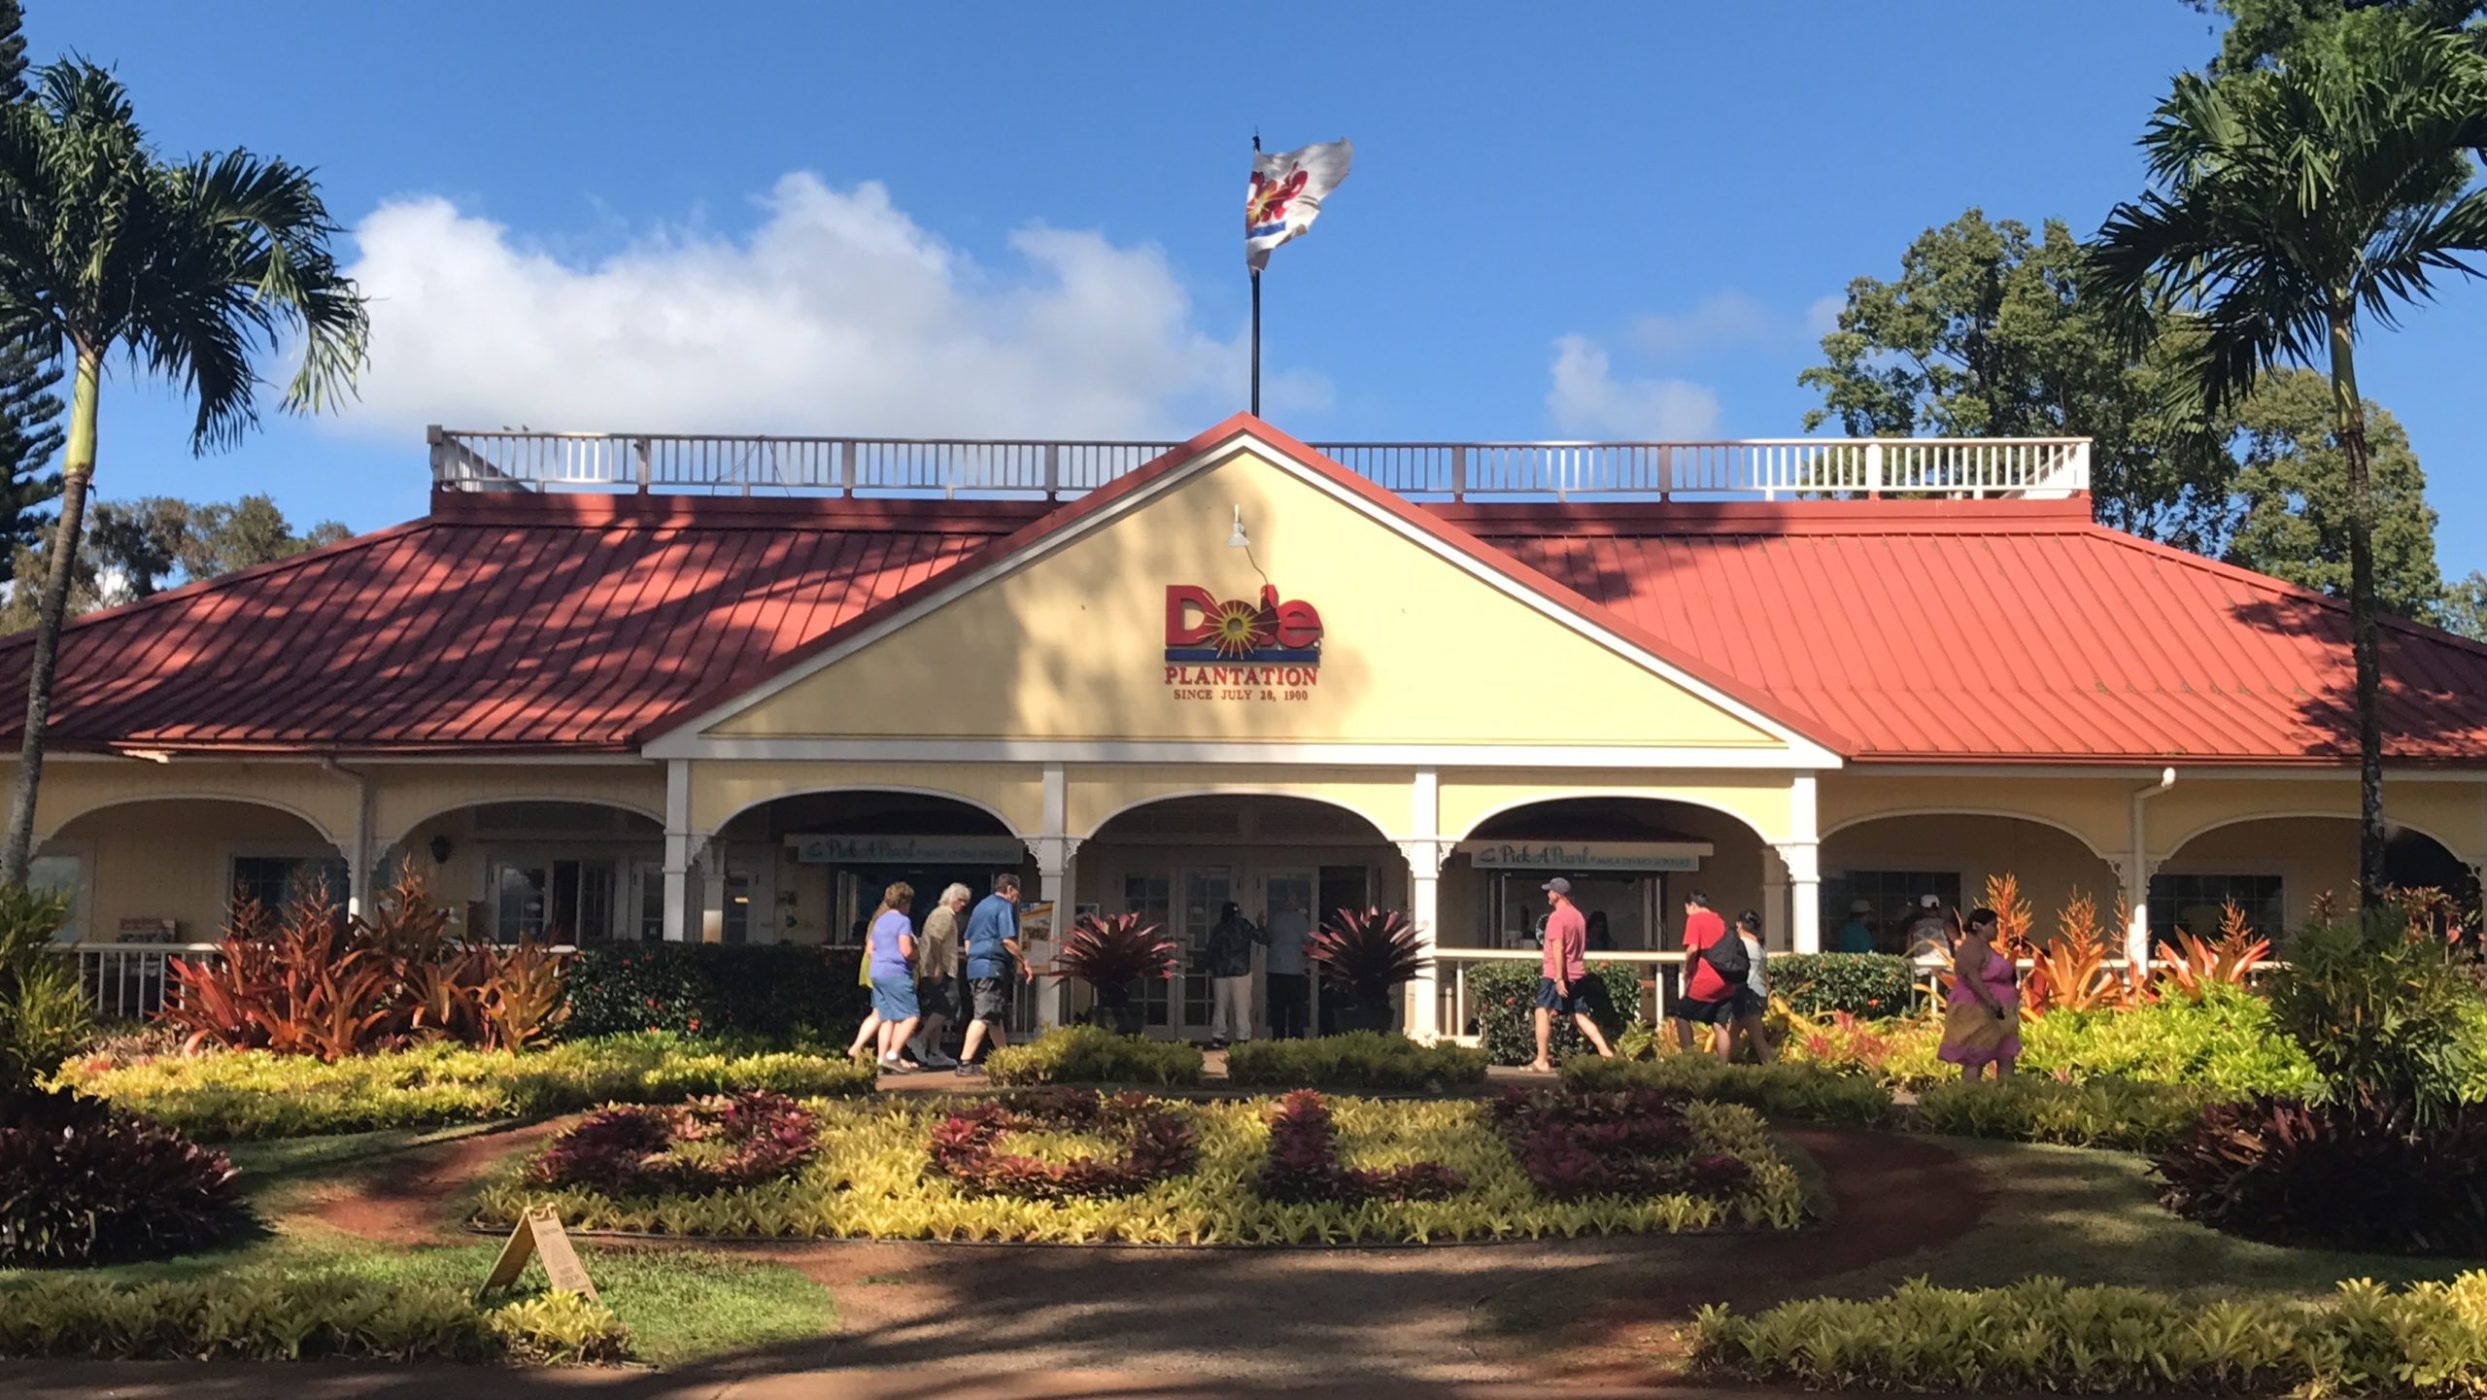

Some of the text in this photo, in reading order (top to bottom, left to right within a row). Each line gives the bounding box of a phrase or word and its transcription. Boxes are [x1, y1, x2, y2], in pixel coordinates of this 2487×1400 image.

[1166, 584, 1323, 649] Dole
[1165, 667, 1318, 686] PLANTATION
[1174, 689, 1213, 700] SINCE
[1221, 690, 1252, 700] JULY
[1500, 845, 1530, 863] Pick
[1531, 846, 1549, 864] A
[1551, 845, 1590, 864] Pearl
